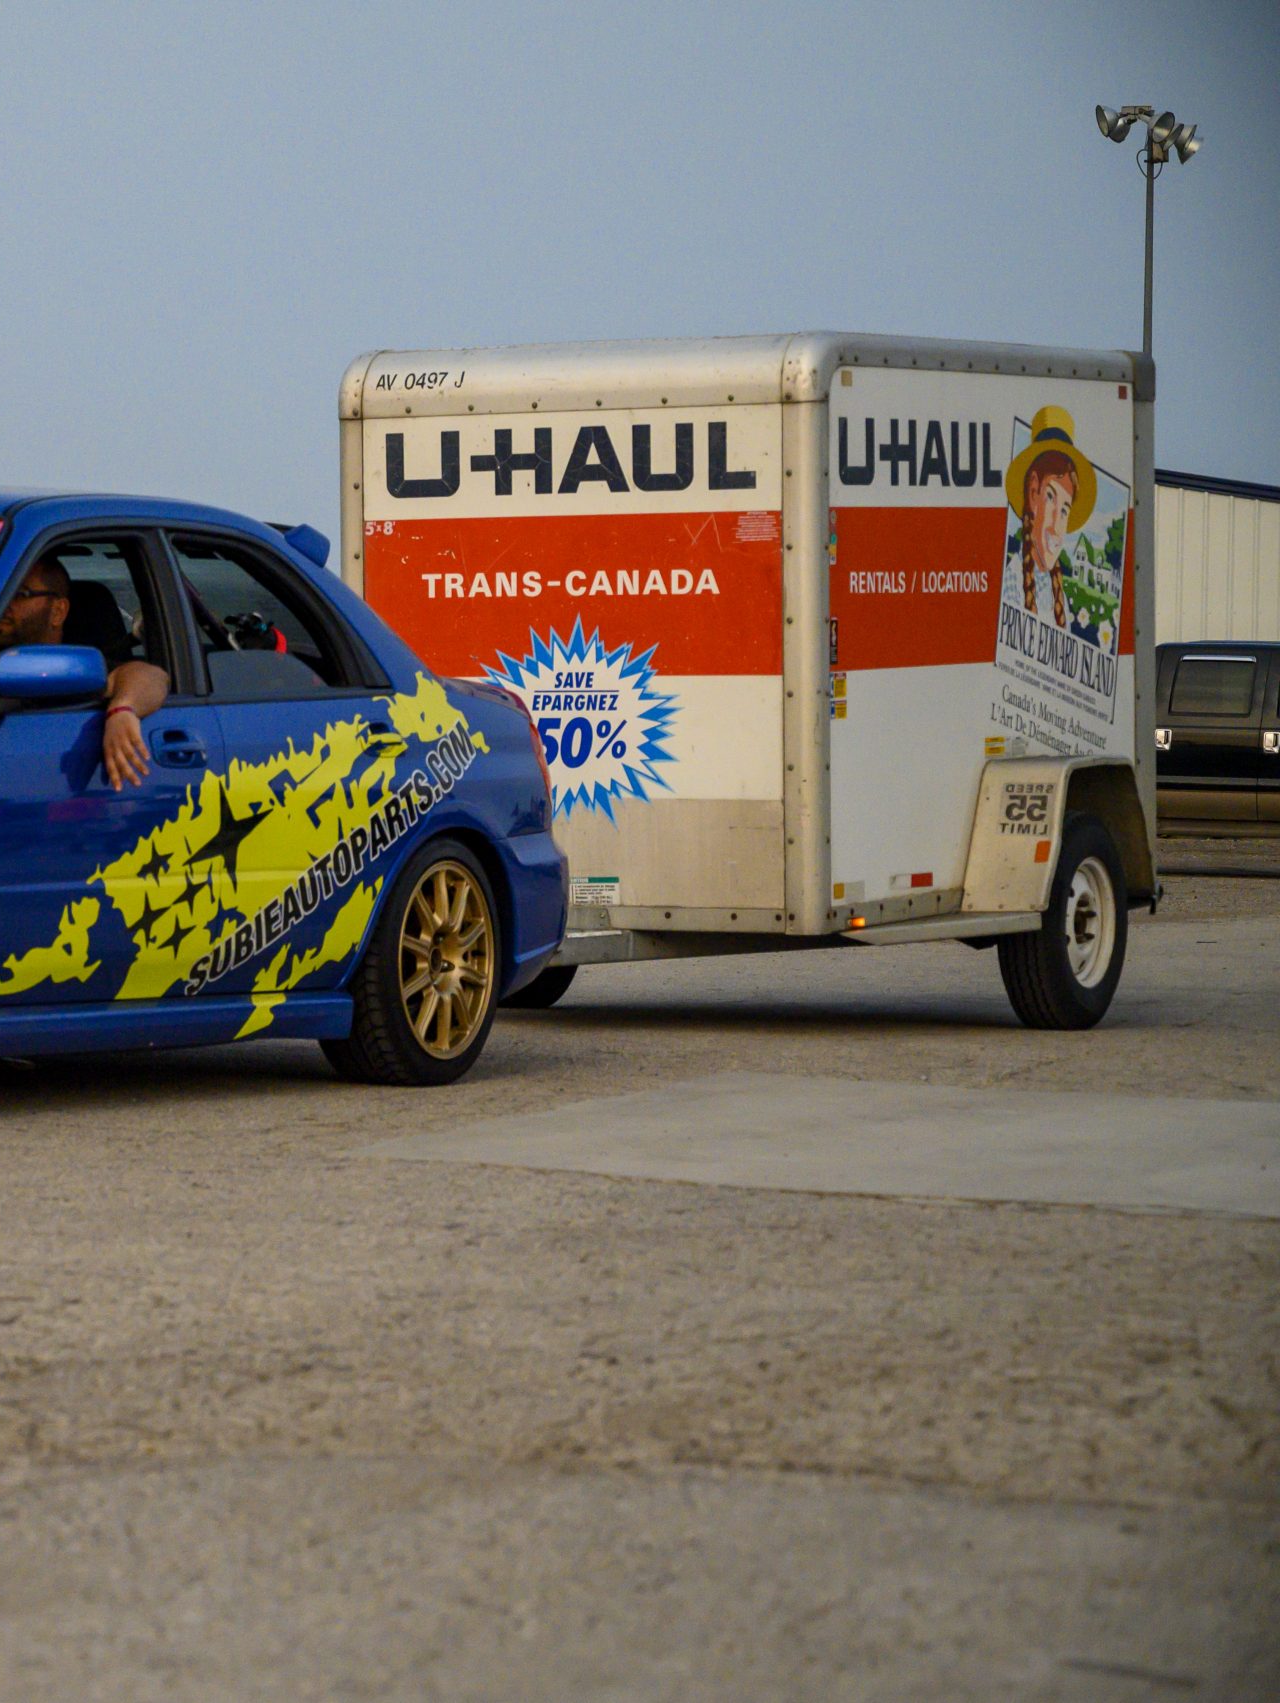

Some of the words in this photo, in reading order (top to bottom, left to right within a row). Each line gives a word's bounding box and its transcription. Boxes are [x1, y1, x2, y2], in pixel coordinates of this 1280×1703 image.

[376, 373, 398, 391] AV
[404, 371, 449, 390] 0497
[454, 371, 466, 389] J
[385, 421, 757, 498] U-HAUL
[838, 417, 1002, 487] U-HAUL
[421, 568, 721, 599] TRANS-CANADA
[849, 571, 906, 593] RENTALS
[921, 571, 988, 593] LOCATIONS
[999, 601, 1038, 659] PRINCE
[1037, 621, 1078, 679] EDWARD
[531, 694, 619, 712] EPARGNEZ
[554, 671, 594, 689] SAVE
[536, 716, 628, 769] 50%
[1002, 684, 1037, 716] Canada's
[1038, 701, 1067, 735] Moving
[1067, 717, 1107, 750] Adventure
[184, 719, 478, 998] SUBIEAUTOPARTS.COM
